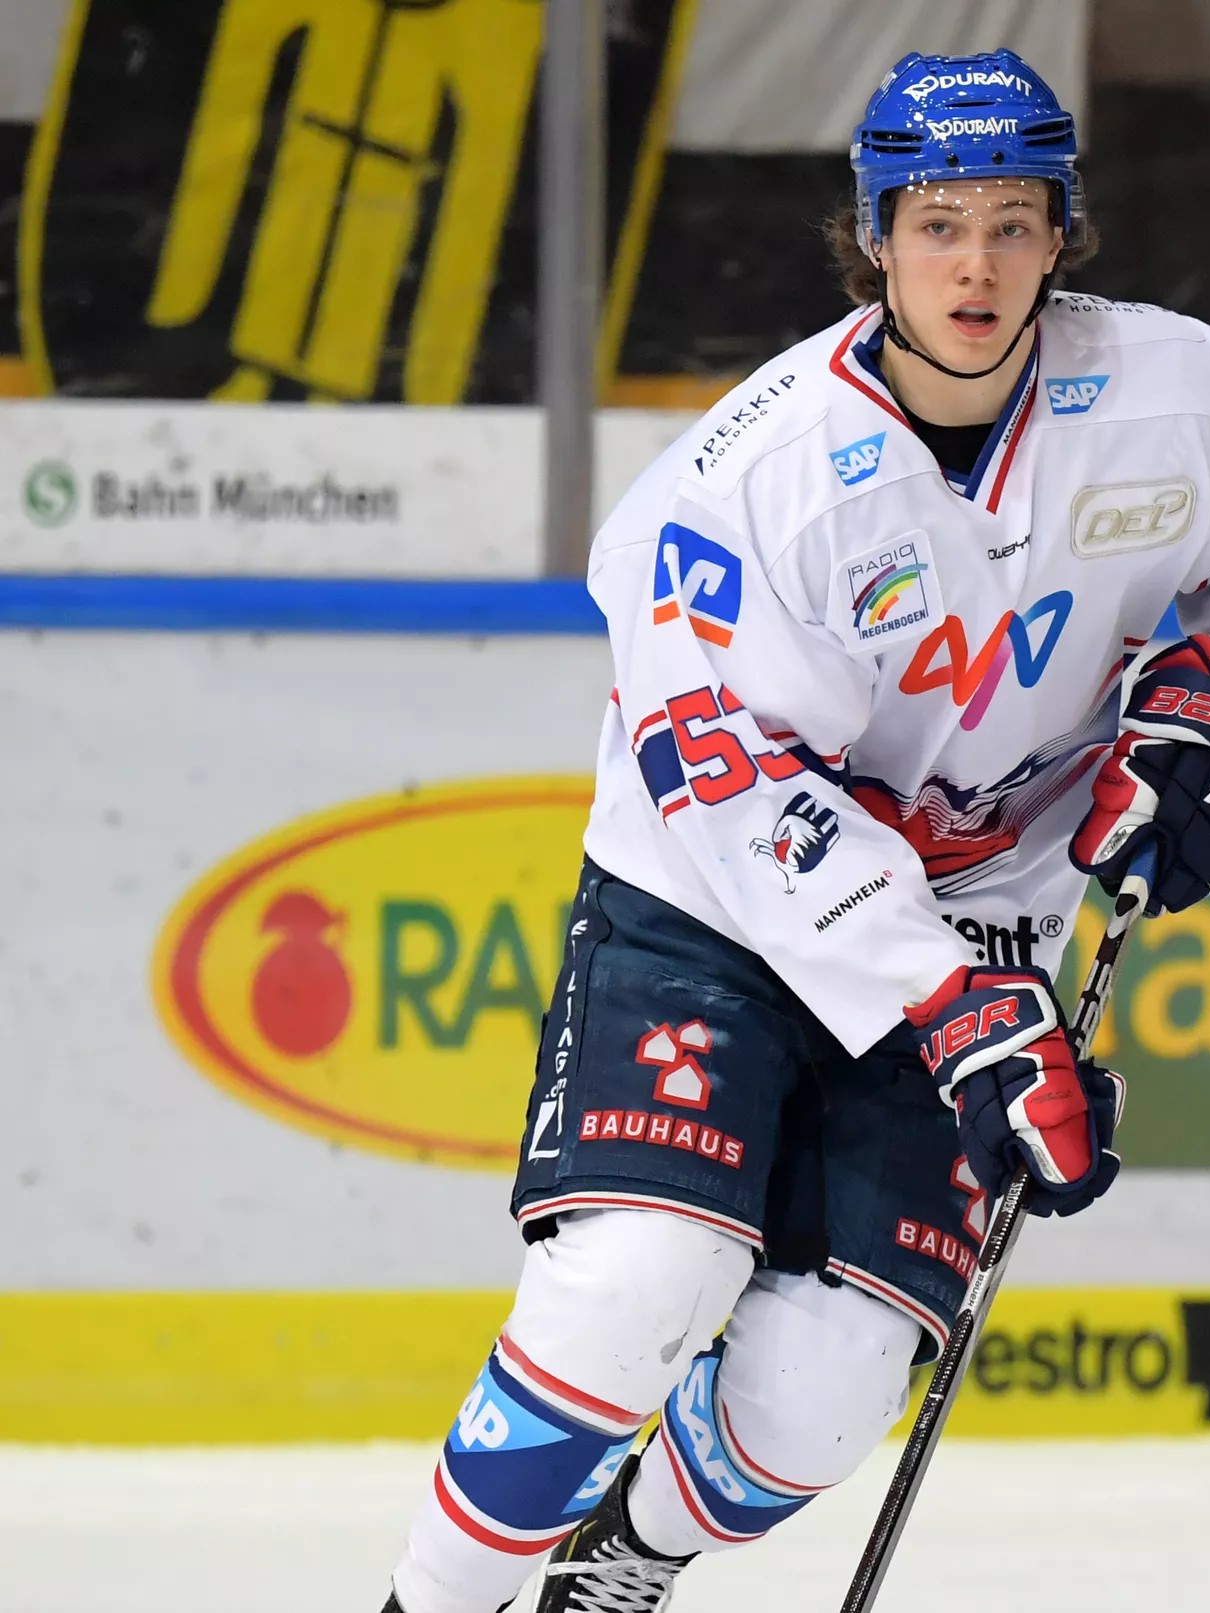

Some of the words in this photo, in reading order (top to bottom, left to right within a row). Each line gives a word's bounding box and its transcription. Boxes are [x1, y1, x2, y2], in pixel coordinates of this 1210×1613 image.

[939, 71, 1032, 97] DURAVIT
[951, 116, 1018, 137] DURAVIT
[1070, 305, 1144, 314] HOLDING
[703, 374, 796, 454] PEKKIP
[1049, 382, 1098, 409] SAP
[710, 409, 768, 468] HOLDING
[834, 444, 879, 481] SAP
[92, 470, 197, 521] Bahn
[211, 470, 400, 524] München
[851, 543, 913, 578] RADIO
[861, 609, 927, 640] REGENBOGEN
[814, 875, 890, 933] MANNHEIM
[376, 896, 572, 1052] RA
[582, 1113, 740, 1163] BAUHAUS
[974, 1318, 1171, 1394] estro
[458, 1382, 509, 1449] AP
[676, 1360, 747, 1503] SAP
